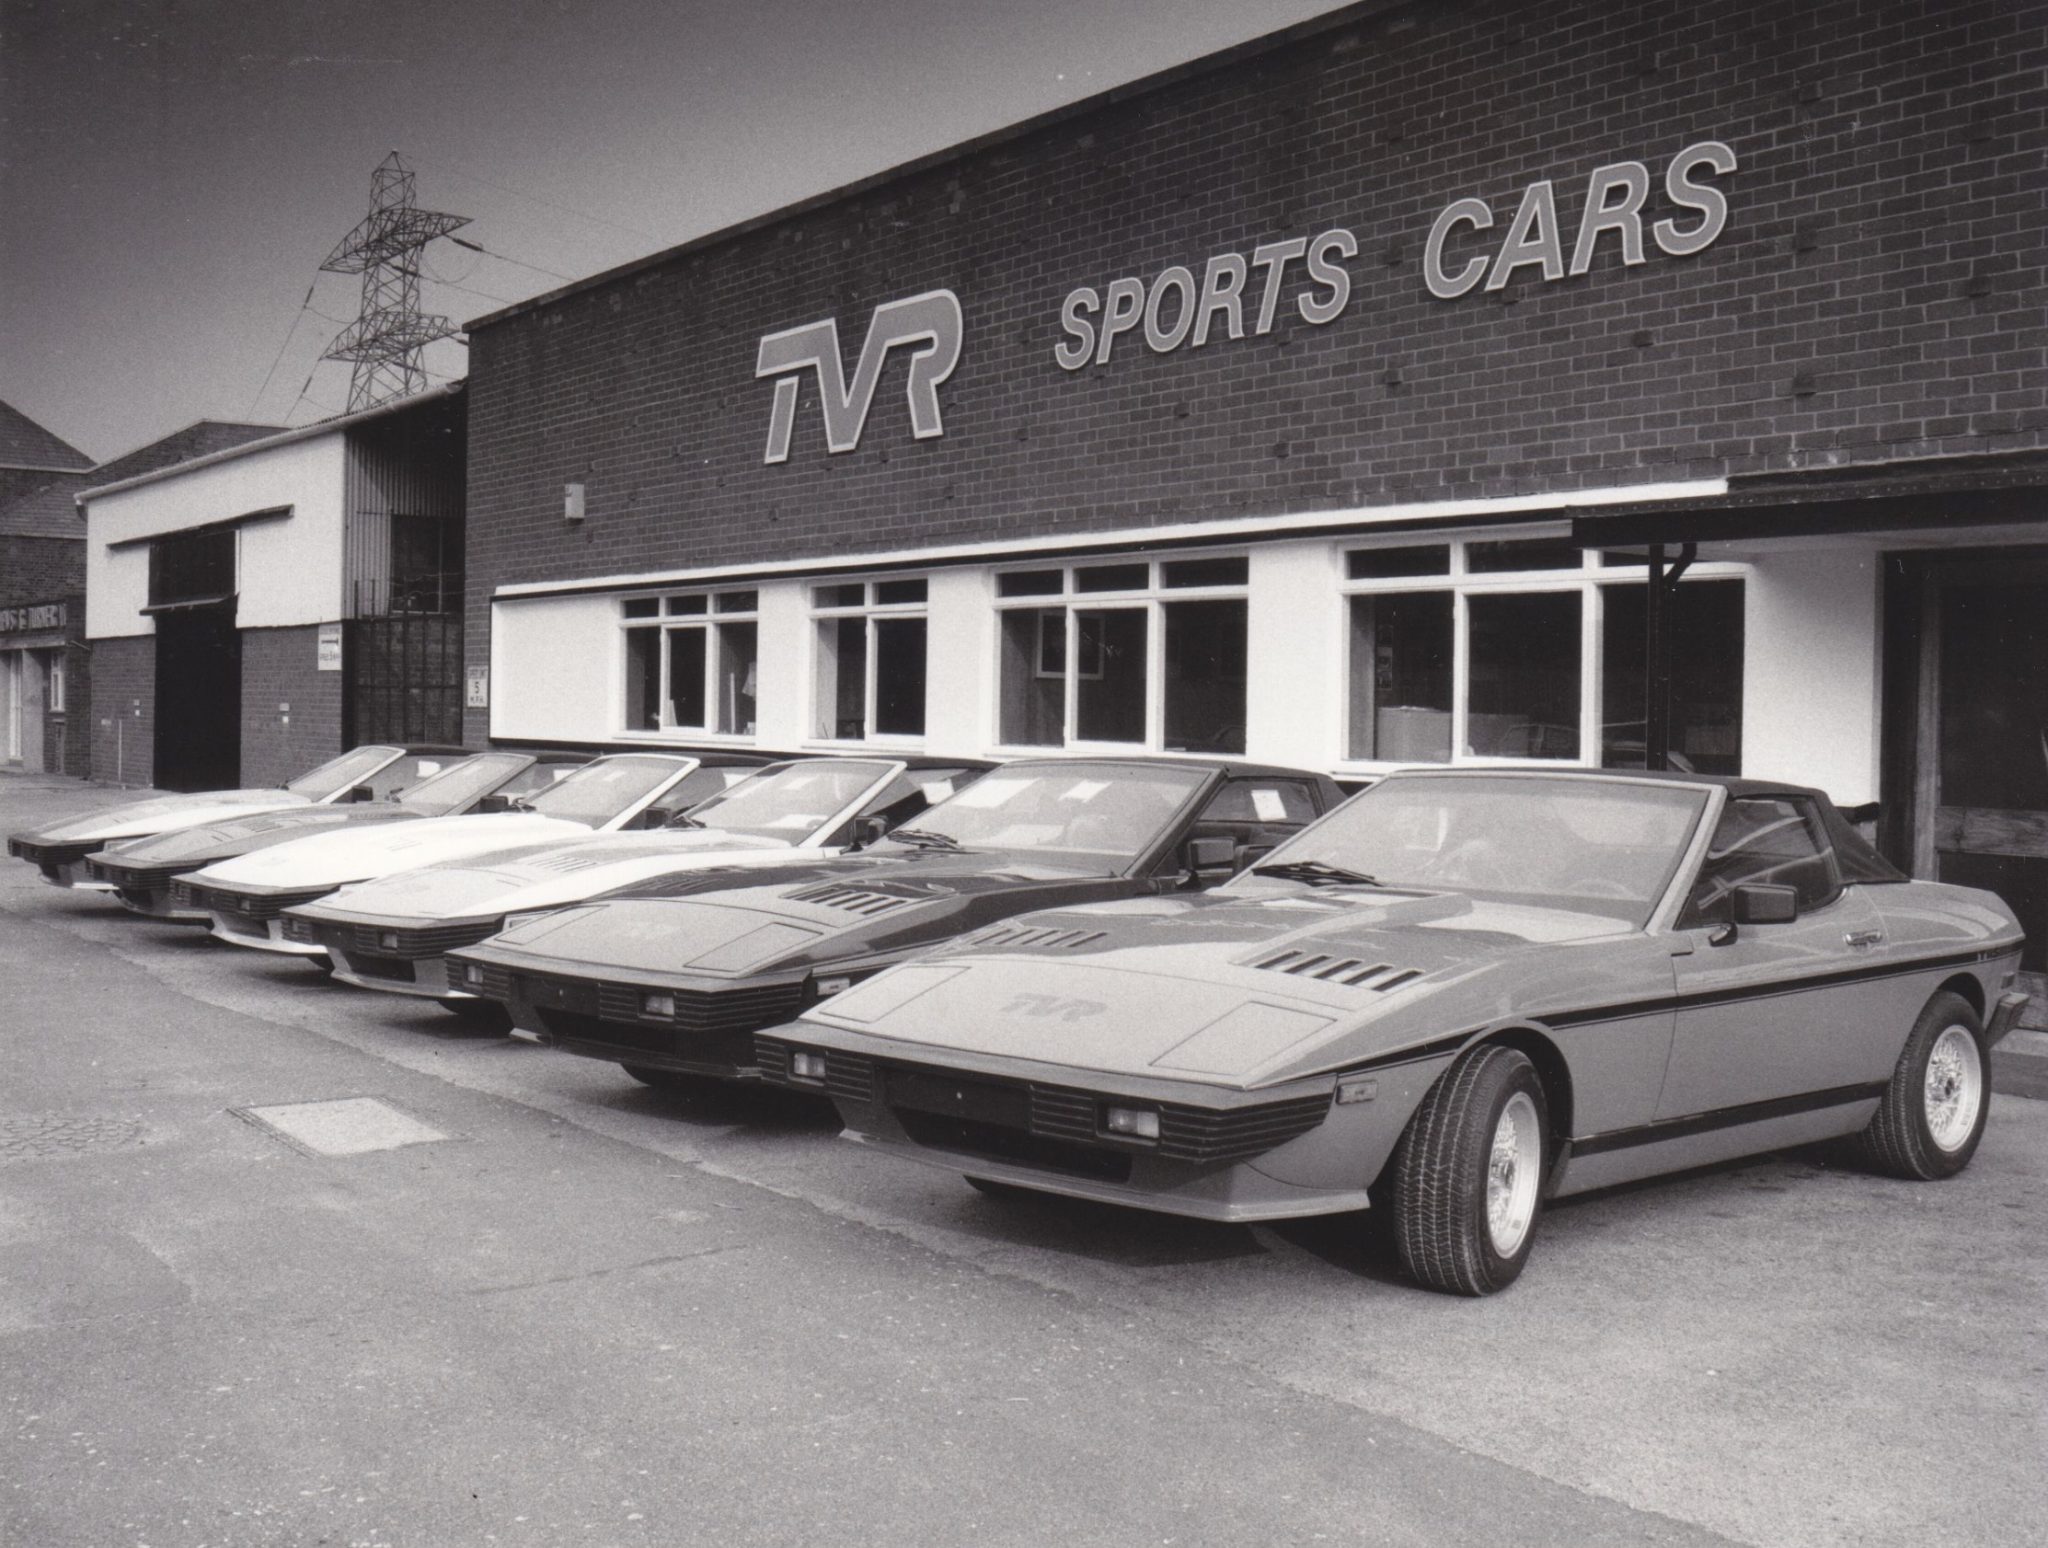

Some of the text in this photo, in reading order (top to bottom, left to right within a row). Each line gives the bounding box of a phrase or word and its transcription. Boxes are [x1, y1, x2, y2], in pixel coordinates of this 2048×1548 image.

[755, 140, 1738, 464] TVR SPORTS CARS
